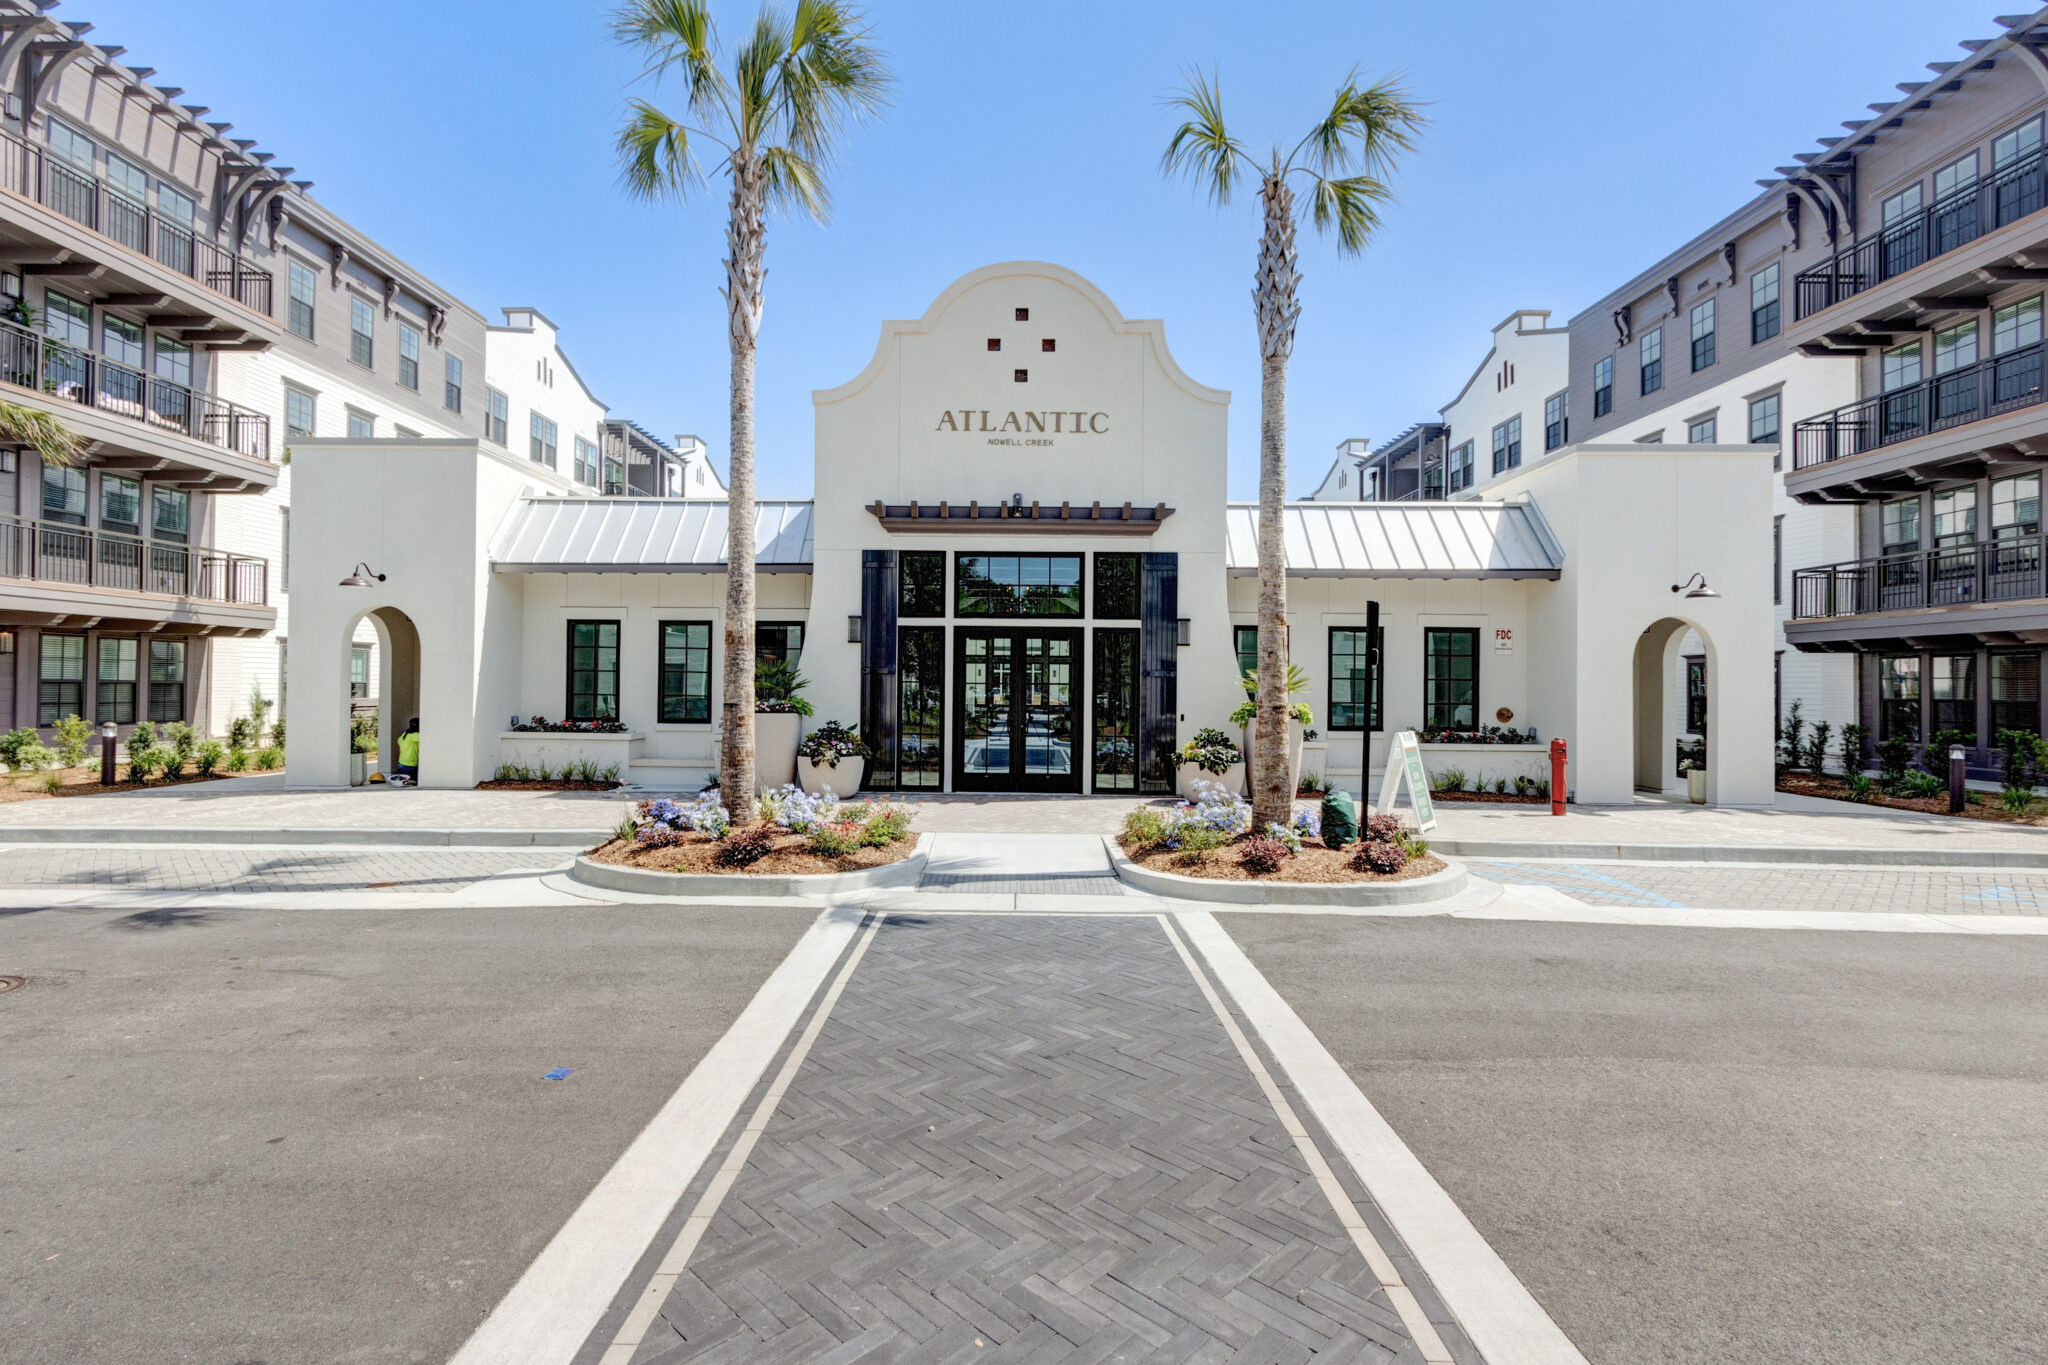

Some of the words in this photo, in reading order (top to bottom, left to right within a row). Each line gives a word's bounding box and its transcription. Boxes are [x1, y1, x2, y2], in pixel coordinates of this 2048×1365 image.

[935, 410, 1109, 434] ATLANTIC
[988, 438, 1022, 447] NOWELL
[1025, 439, 1055, 447] CREEK
[1495, 629, 1512, 640] FDC
